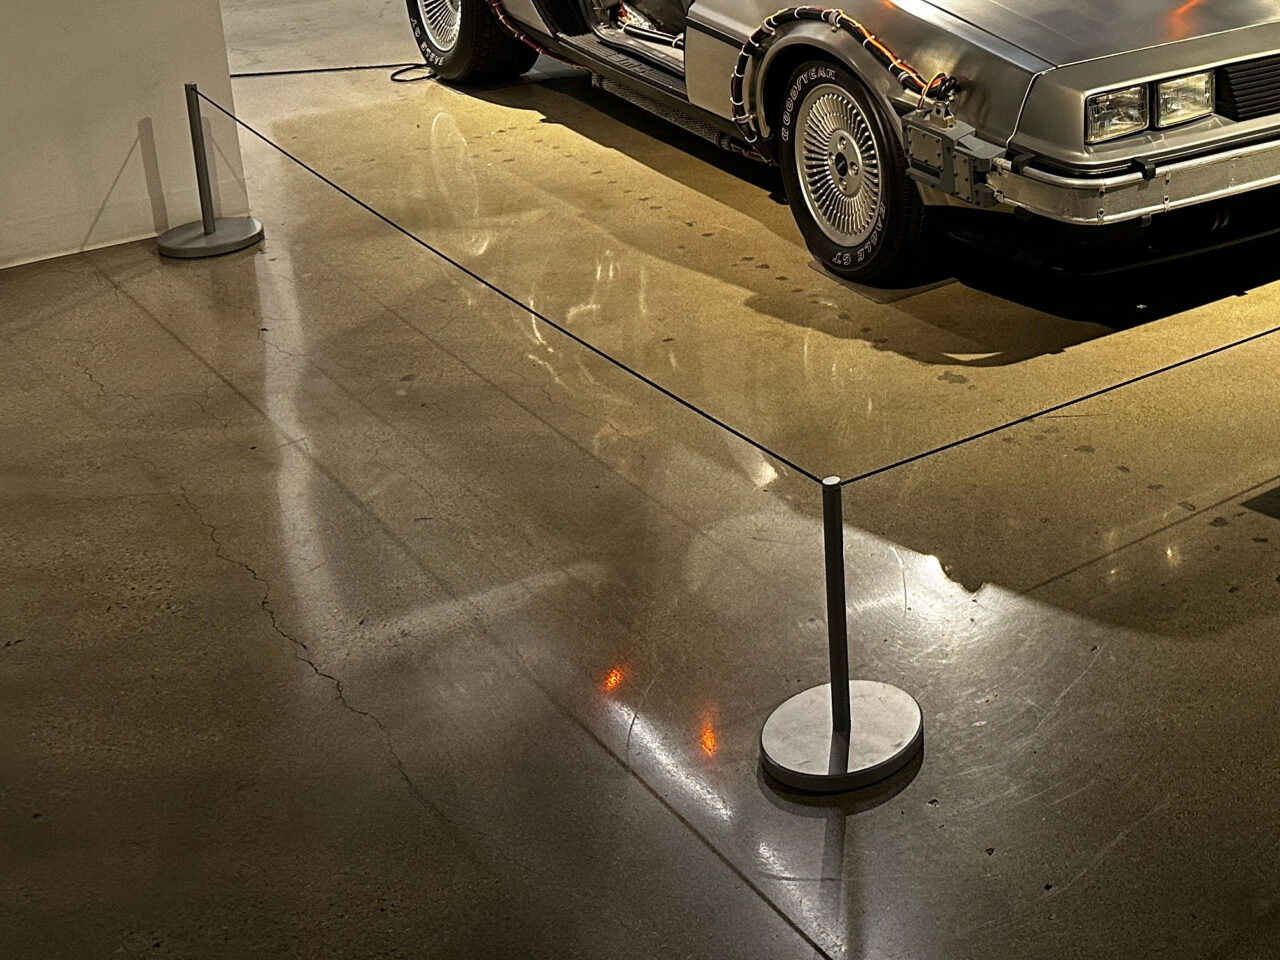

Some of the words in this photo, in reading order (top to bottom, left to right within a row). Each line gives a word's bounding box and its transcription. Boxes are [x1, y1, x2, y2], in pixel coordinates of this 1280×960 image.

[781, 66, 837, 142] GOODYEAR
[832, 252, 852, 266] GT
[857, 201, 887, 263] EAGLE
